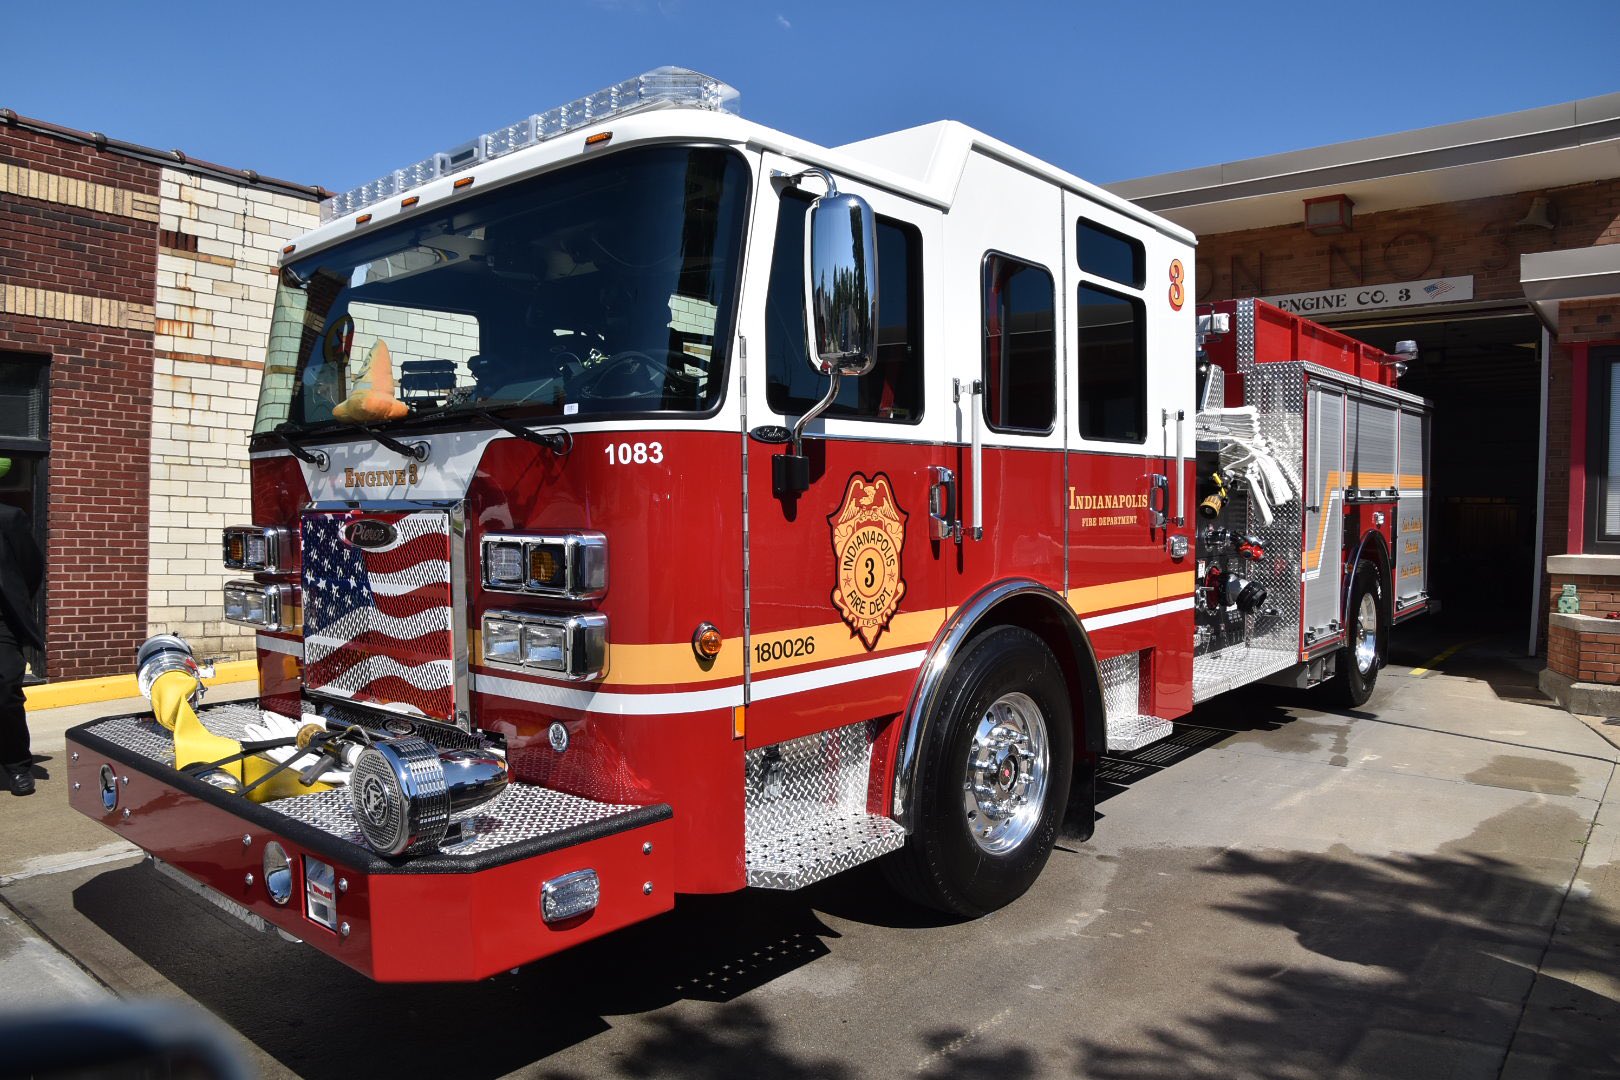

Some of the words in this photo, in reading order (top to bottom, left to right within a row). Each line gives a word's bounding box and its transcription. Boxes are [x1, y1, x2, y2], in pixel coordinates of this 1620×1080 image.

[1168, 258, 1185, 312] 3
[1278, 293, 1348, 313] ENGINE
[1356, 290, 1389, 306] CO.
[1398, 288, 1411, 302] 3
[604, 441, 664, 465] 1083
[344, 467, 406, 488] ENGINE
[409, 464, 418, 484] 3
[1069, 486, 1148, 510] INDIANAPOLIS
[1081, 517, 1097, 527] FIRE
[1098, 515, 1138, 526] DEPARTMENT
[843, 531, 895, 571] INDIANAPOLIS
[865, 558, 875, 587] 3
[846, 589, 867, 616] FIRE
[869, 587, 894, 616] DEPT.
[754, 635, 816, 664] 180026
